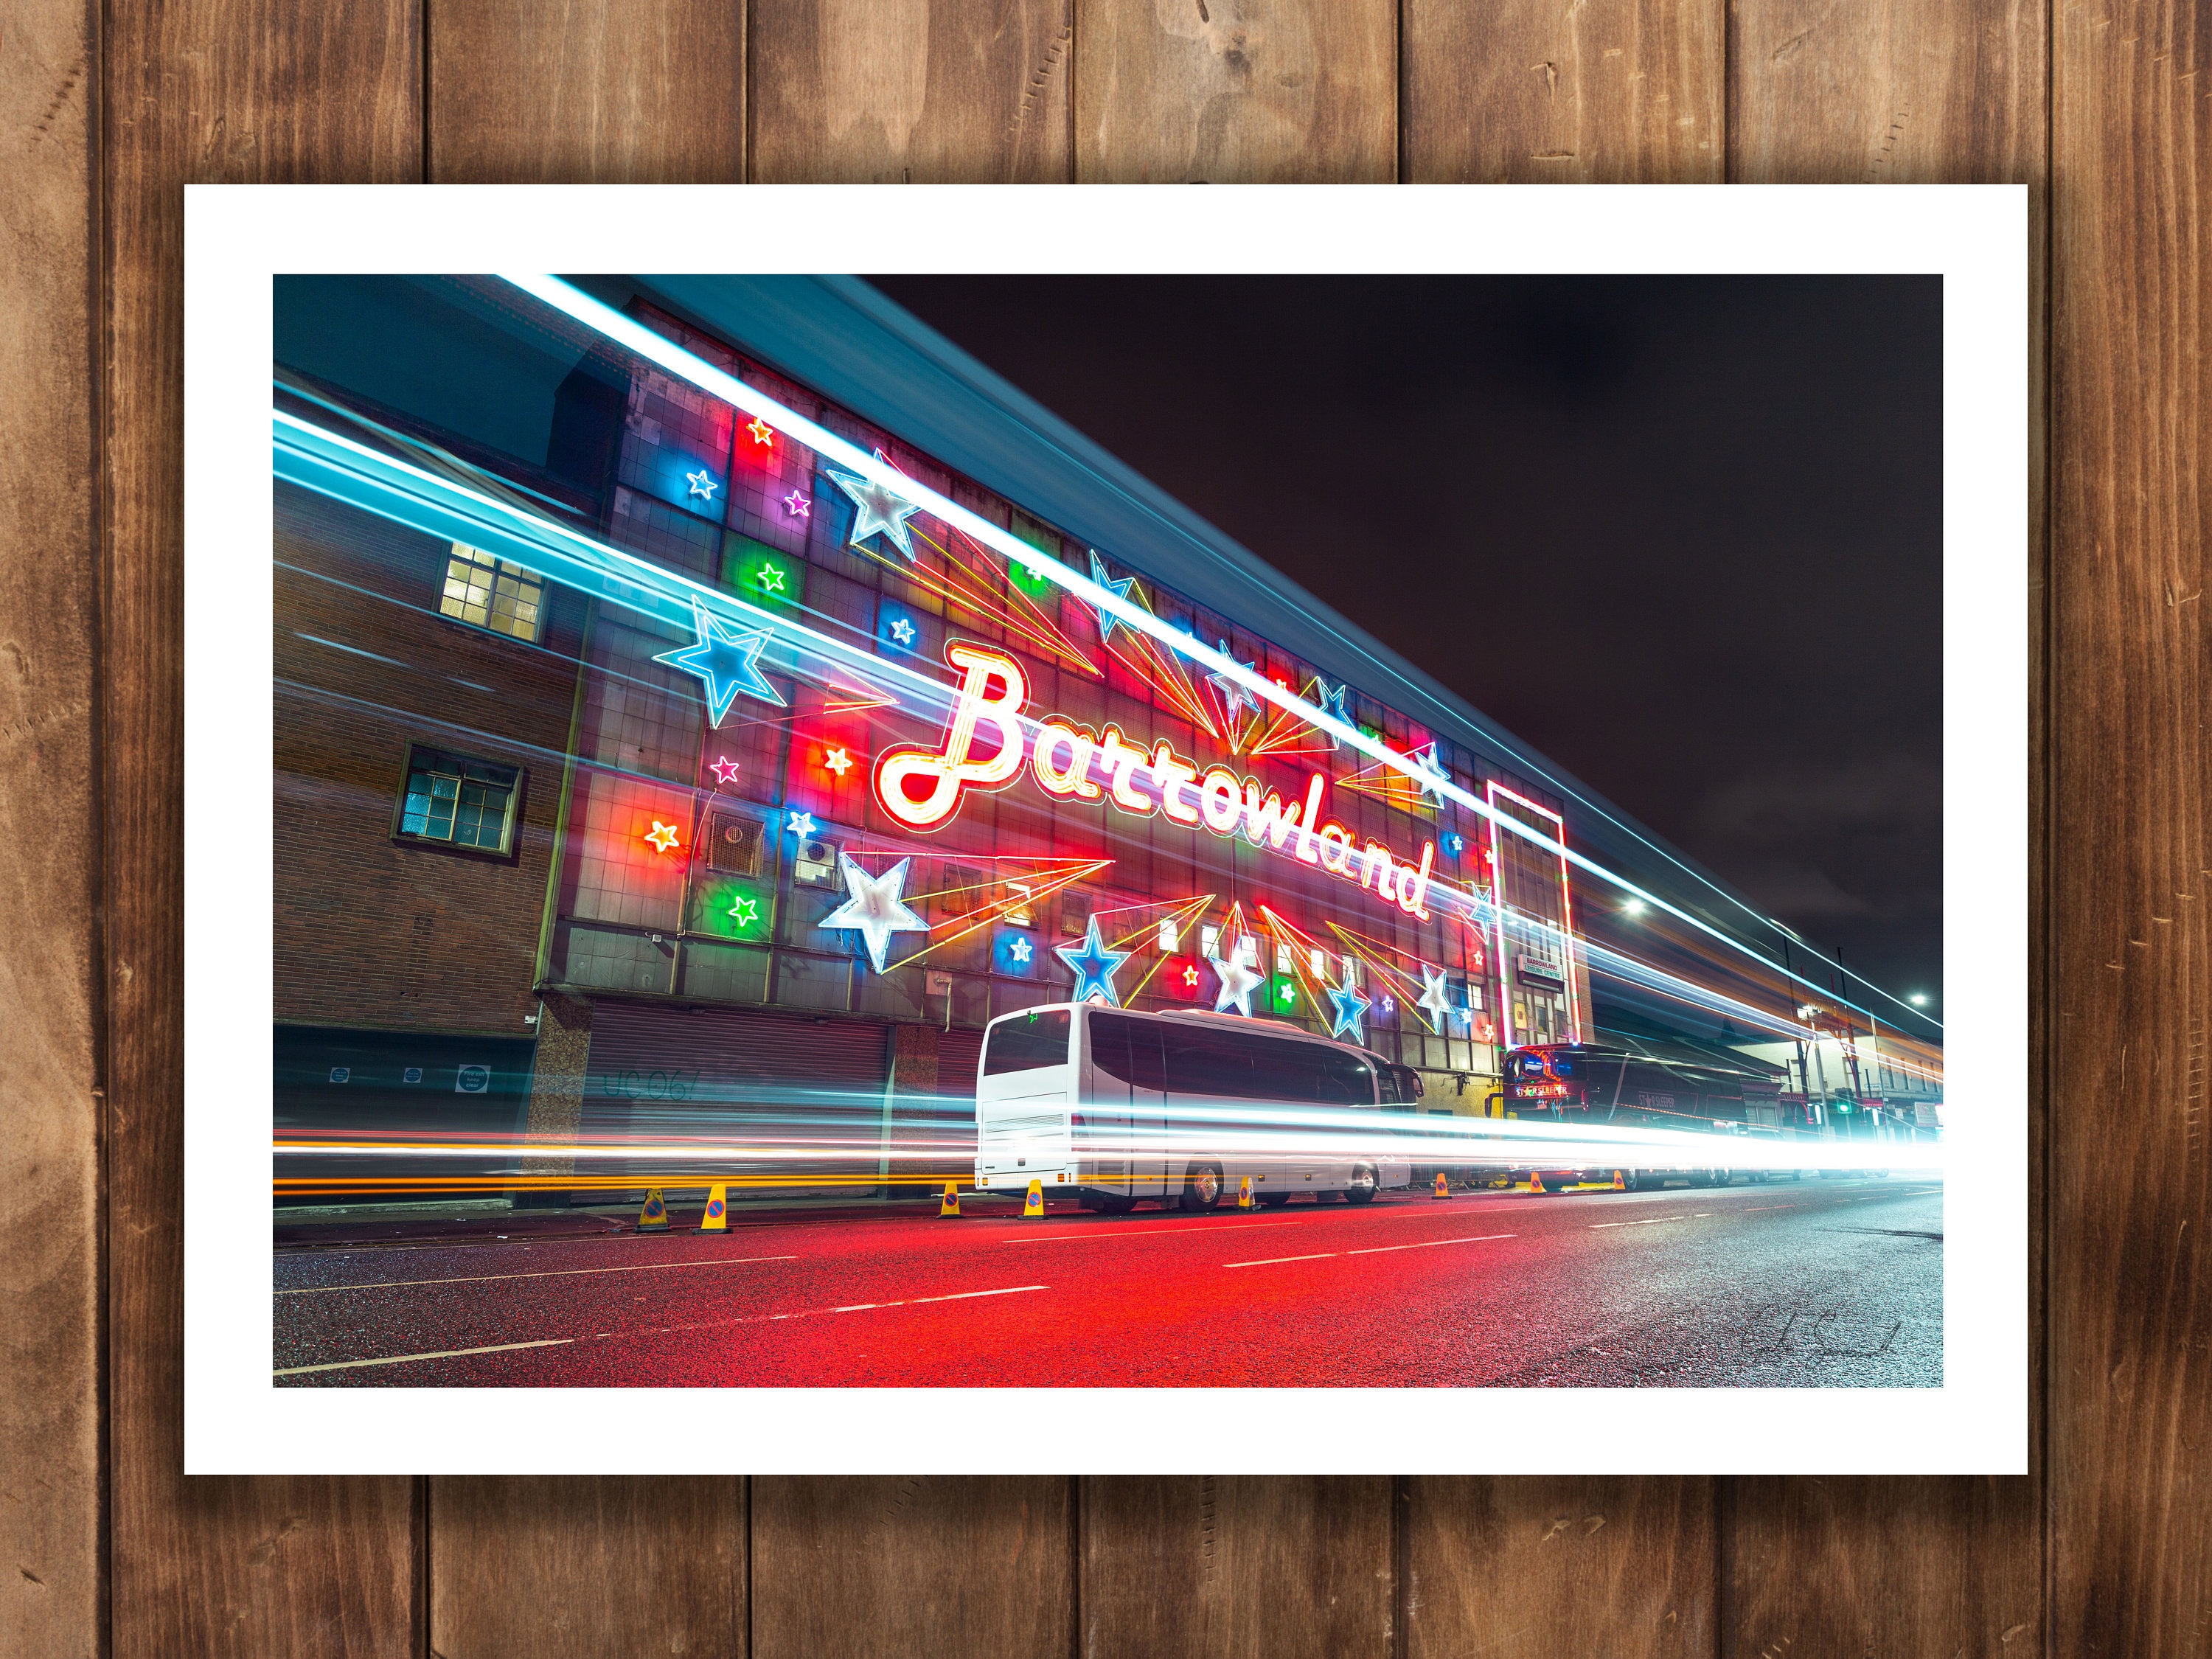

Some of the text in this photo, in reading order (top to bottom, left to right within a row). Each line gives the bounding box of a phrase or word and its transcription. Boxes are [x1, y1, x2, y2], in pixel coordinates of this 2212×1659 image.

[873, 639, 1431, 924] Barrowland
[1526, 958, 1557, 970] BARROWLAND
[1525, 964, 1560, 979] LEISURE CENTRE
[1538, 1087, 1568, 1095] SLEEPER
